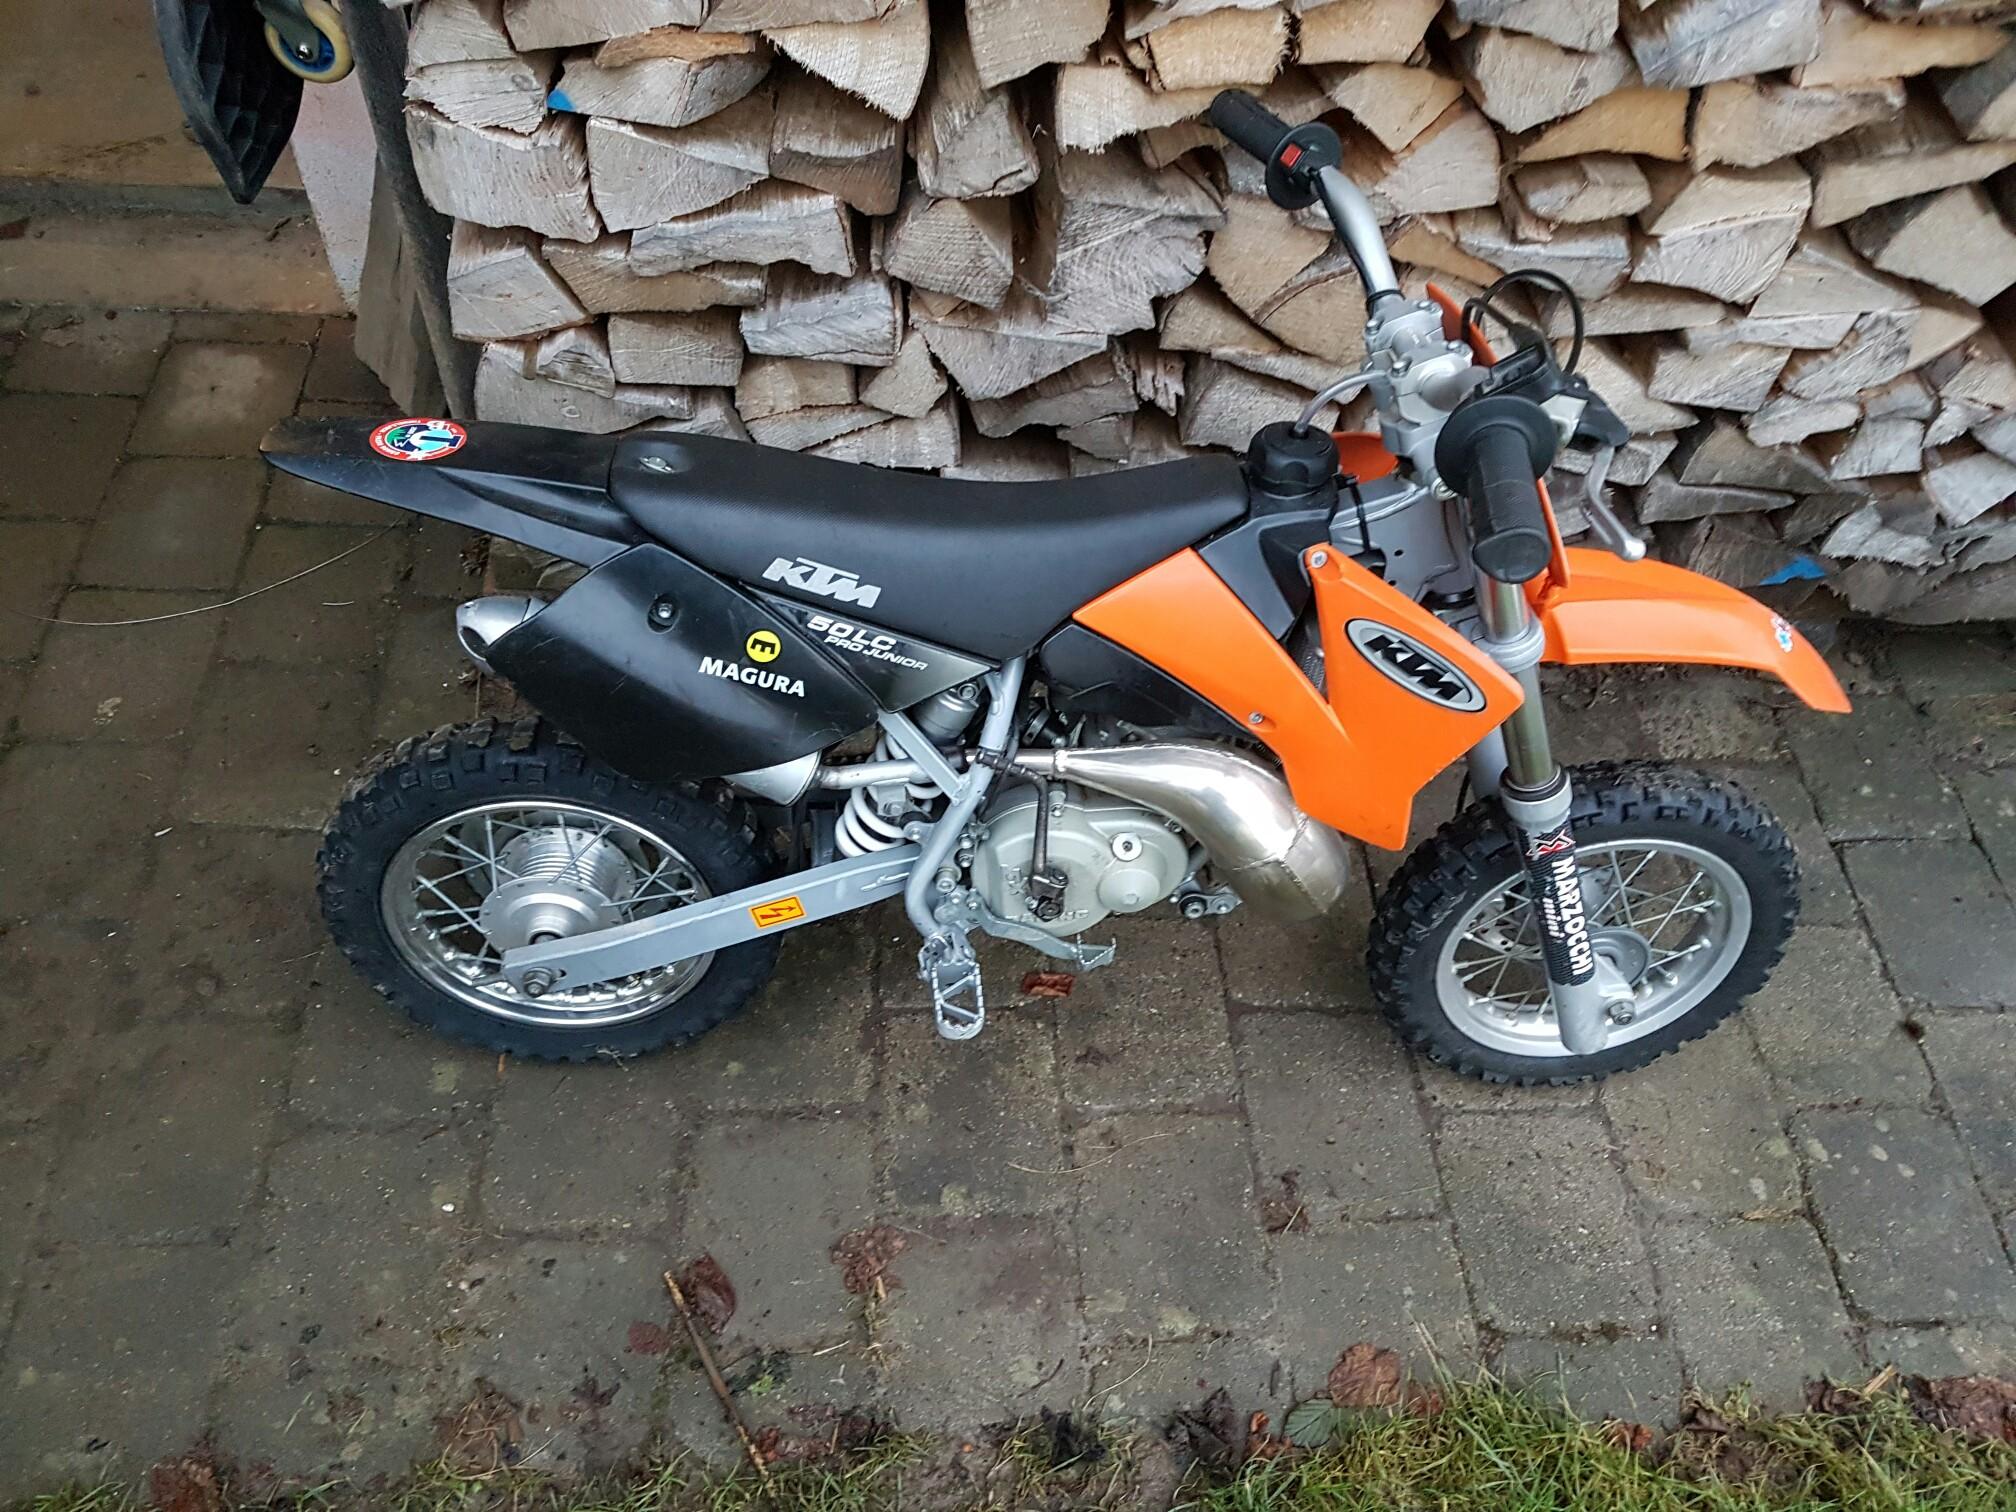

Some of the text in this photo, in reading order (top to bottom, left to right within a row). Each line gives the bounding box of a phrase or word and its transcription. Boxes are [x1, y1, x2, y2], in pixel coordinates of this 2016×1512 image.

[762, 556, 882, 609] KTM
[824, 635, 929, 671] PRO JUNIOR
[1364, 634, 1464, 701] KTM
[698, 656, 806, 698] MAGURA
[1542, 897, 1566, 939] mini
[1551, 855, 1594, 976] MARZOCCHI
